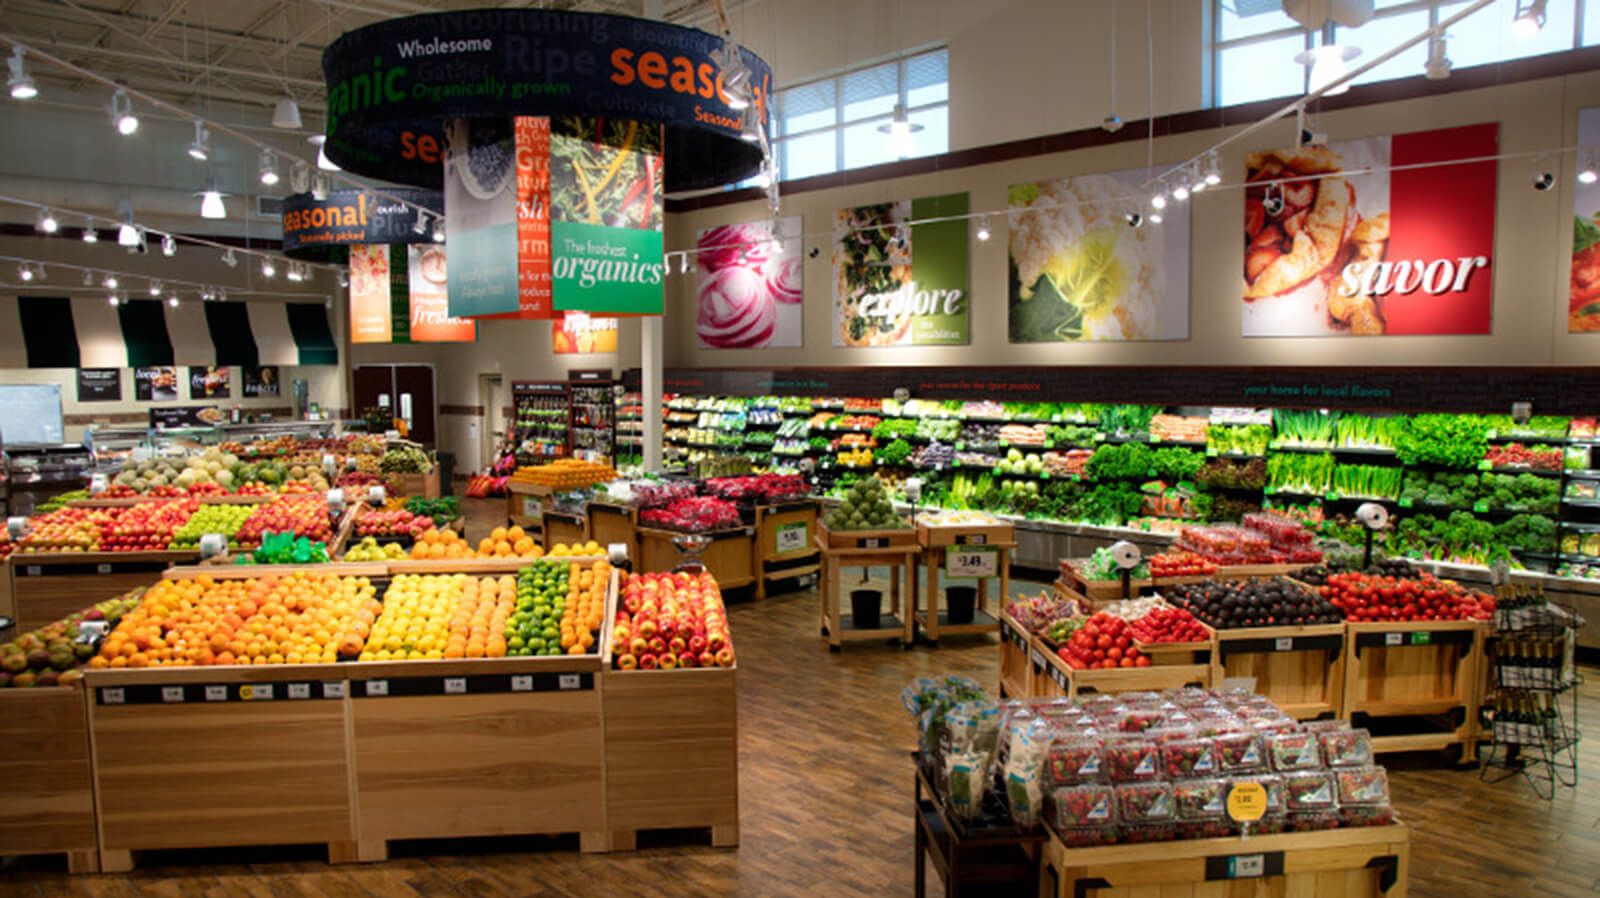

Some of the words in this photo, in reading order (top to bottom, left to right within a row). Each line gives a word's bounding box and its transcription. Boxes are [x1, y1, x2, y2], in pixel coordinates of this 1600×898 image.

[397, 36, 492, 59] Wholesome
[503, 34, 596, 83] Ripe
[412, 77, 506, 101] Organically
[511, 80, 571, 98] grown
[610, 47, 767, 126] seasal
[553, 253, 662, 288] organics
[1339, 255, 1488, 297] savor
[859, 281, 963, 325] explore
